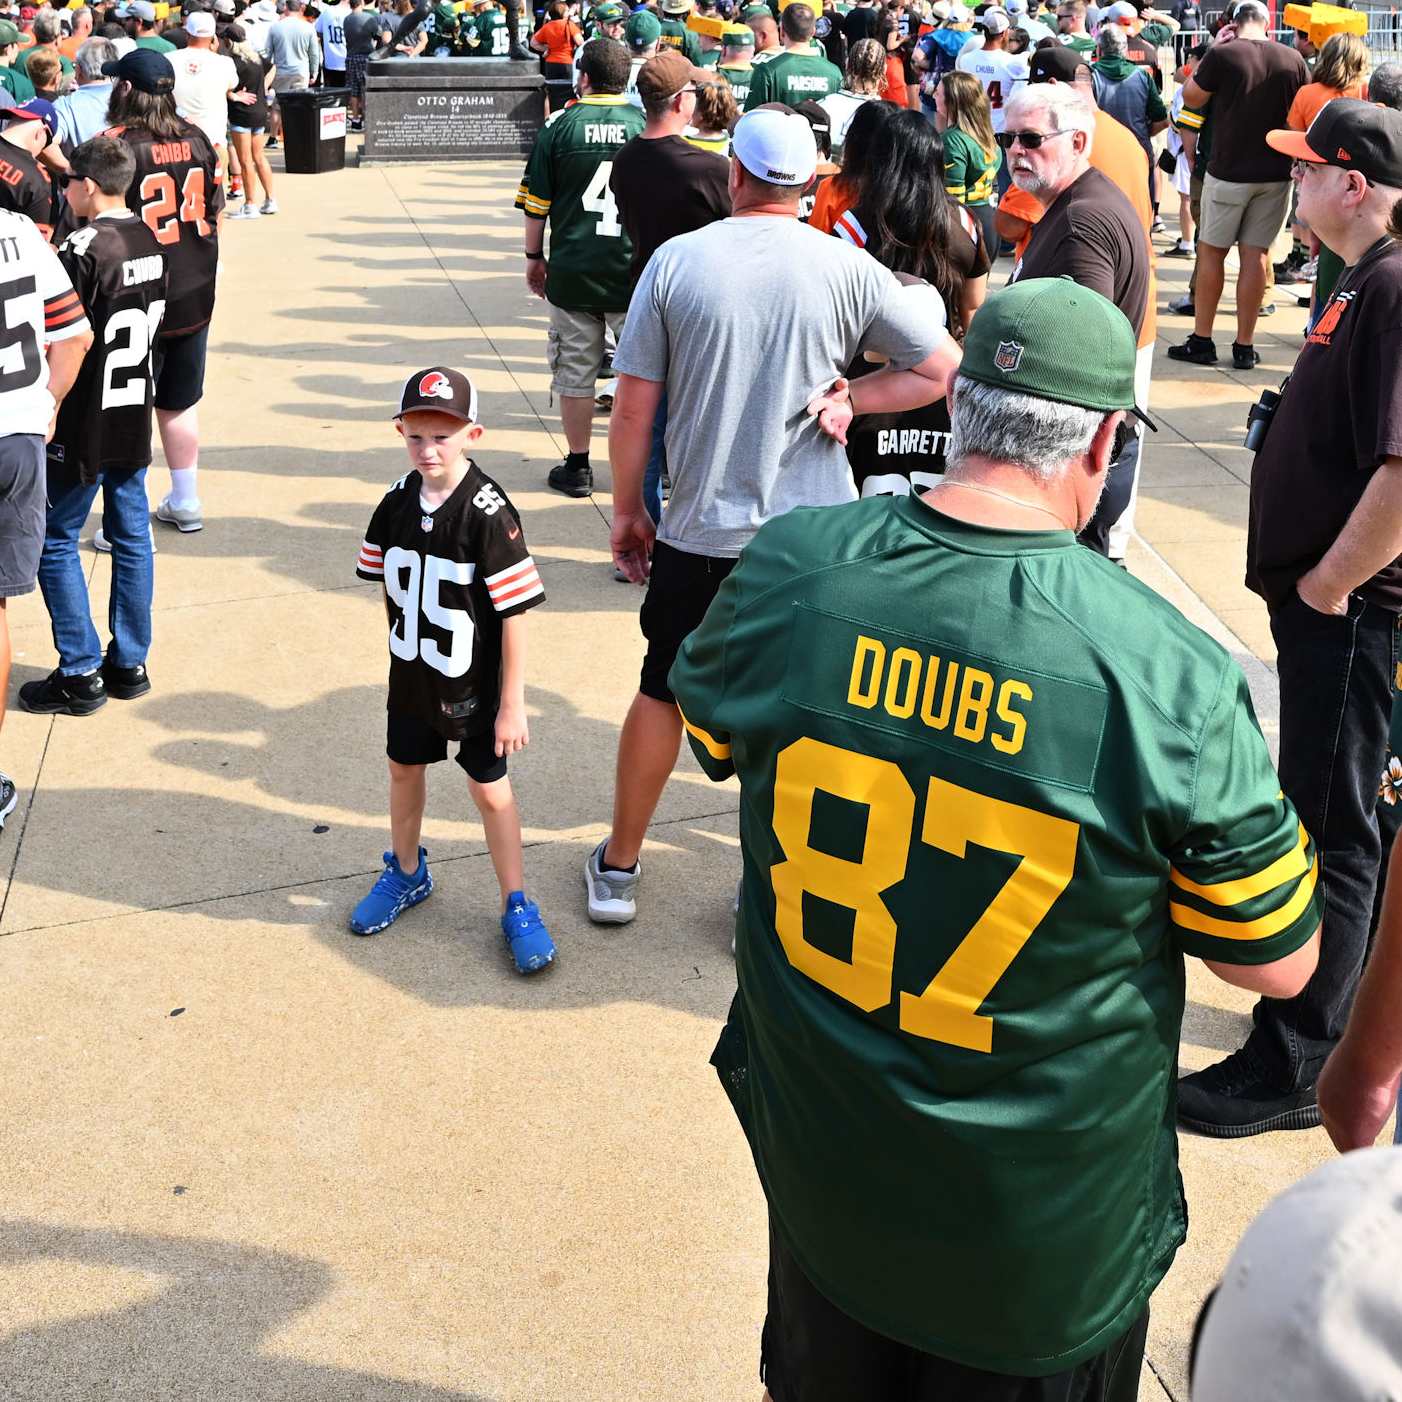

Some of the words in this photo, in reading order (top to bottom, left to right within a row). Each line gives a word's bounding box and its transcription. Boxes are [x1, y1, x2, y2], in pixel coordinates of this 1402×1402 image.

[975, 64, 995, 74] CHUBB
[787, 75, 829, 93] PARSONS
[986, 80, 1004, 109] 4
[417, 96, 447, 106] OTTO
[450, 96, 494, 106] GRAHAM
[584, 124, 627, 144] FAVRE
[766, 169, 796, 182] BROWNS
[140, 167, 211, 246] 24
[122, 253, 164, 287] CHUBB
[877, 428, 952, 456] GARRETT
[472, 482, 507, 517] 95
[383, 545, 476, 679] 95
[847, 634, 1034, 756] DOUBS
[770, 736, 1080, 1054] 87
